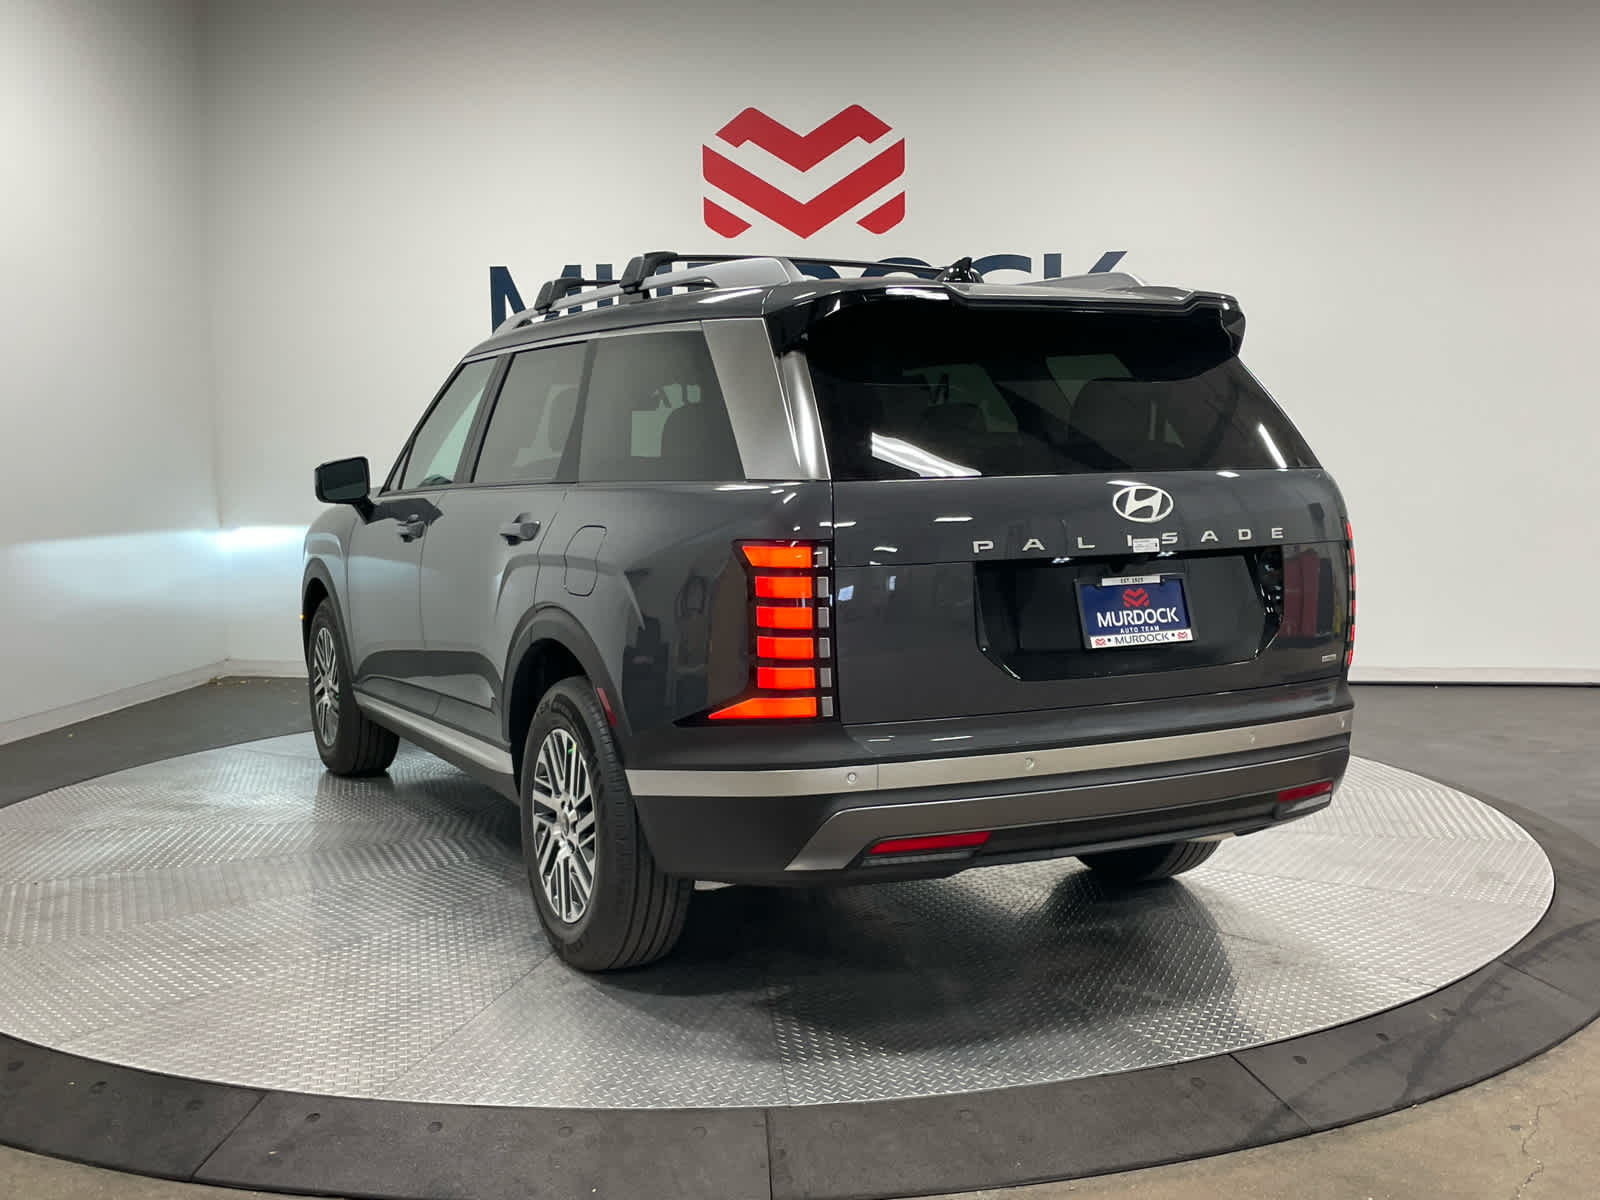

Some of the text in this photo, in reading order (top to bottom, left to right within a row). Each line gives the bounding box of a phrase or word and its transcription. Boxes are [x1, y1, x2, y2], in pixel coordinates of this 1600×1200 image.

[973, 527, 1284, 553] PALISADE
[1096, 607, 1179, 628] MURDOCK
[1141, 625, 1160, 633] TEAM
[1114, 632, 1170, 645] MURDOCK
